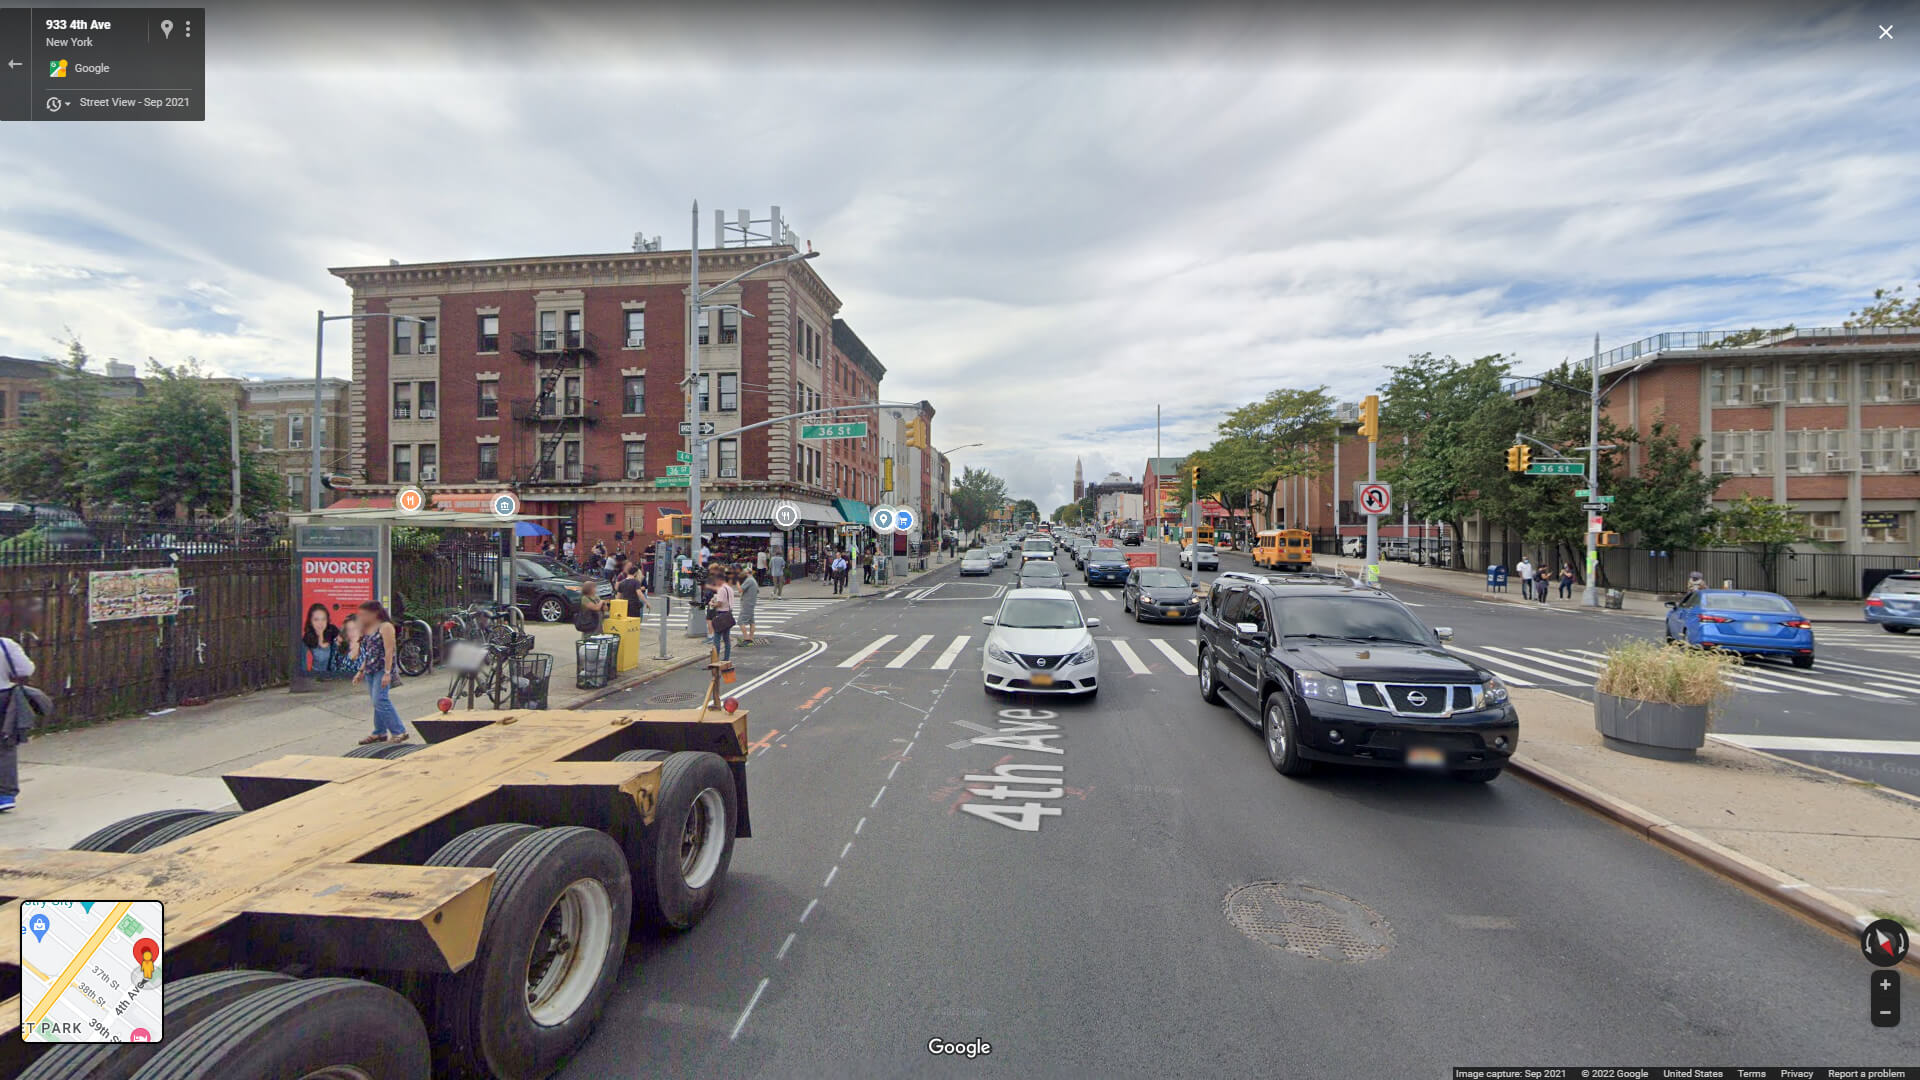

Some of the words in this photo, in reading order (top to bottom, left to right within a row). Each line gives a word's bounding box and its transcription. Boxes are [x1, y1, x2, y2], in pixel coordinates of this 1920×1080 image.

[818, 426, 834, 437] 36
[837, 426, 852, 436] St
[1540, 465, 1554, 473] 36
[1557, 465, 1570, 473] St
[305, 561, 370, 574] DIVORCE?
